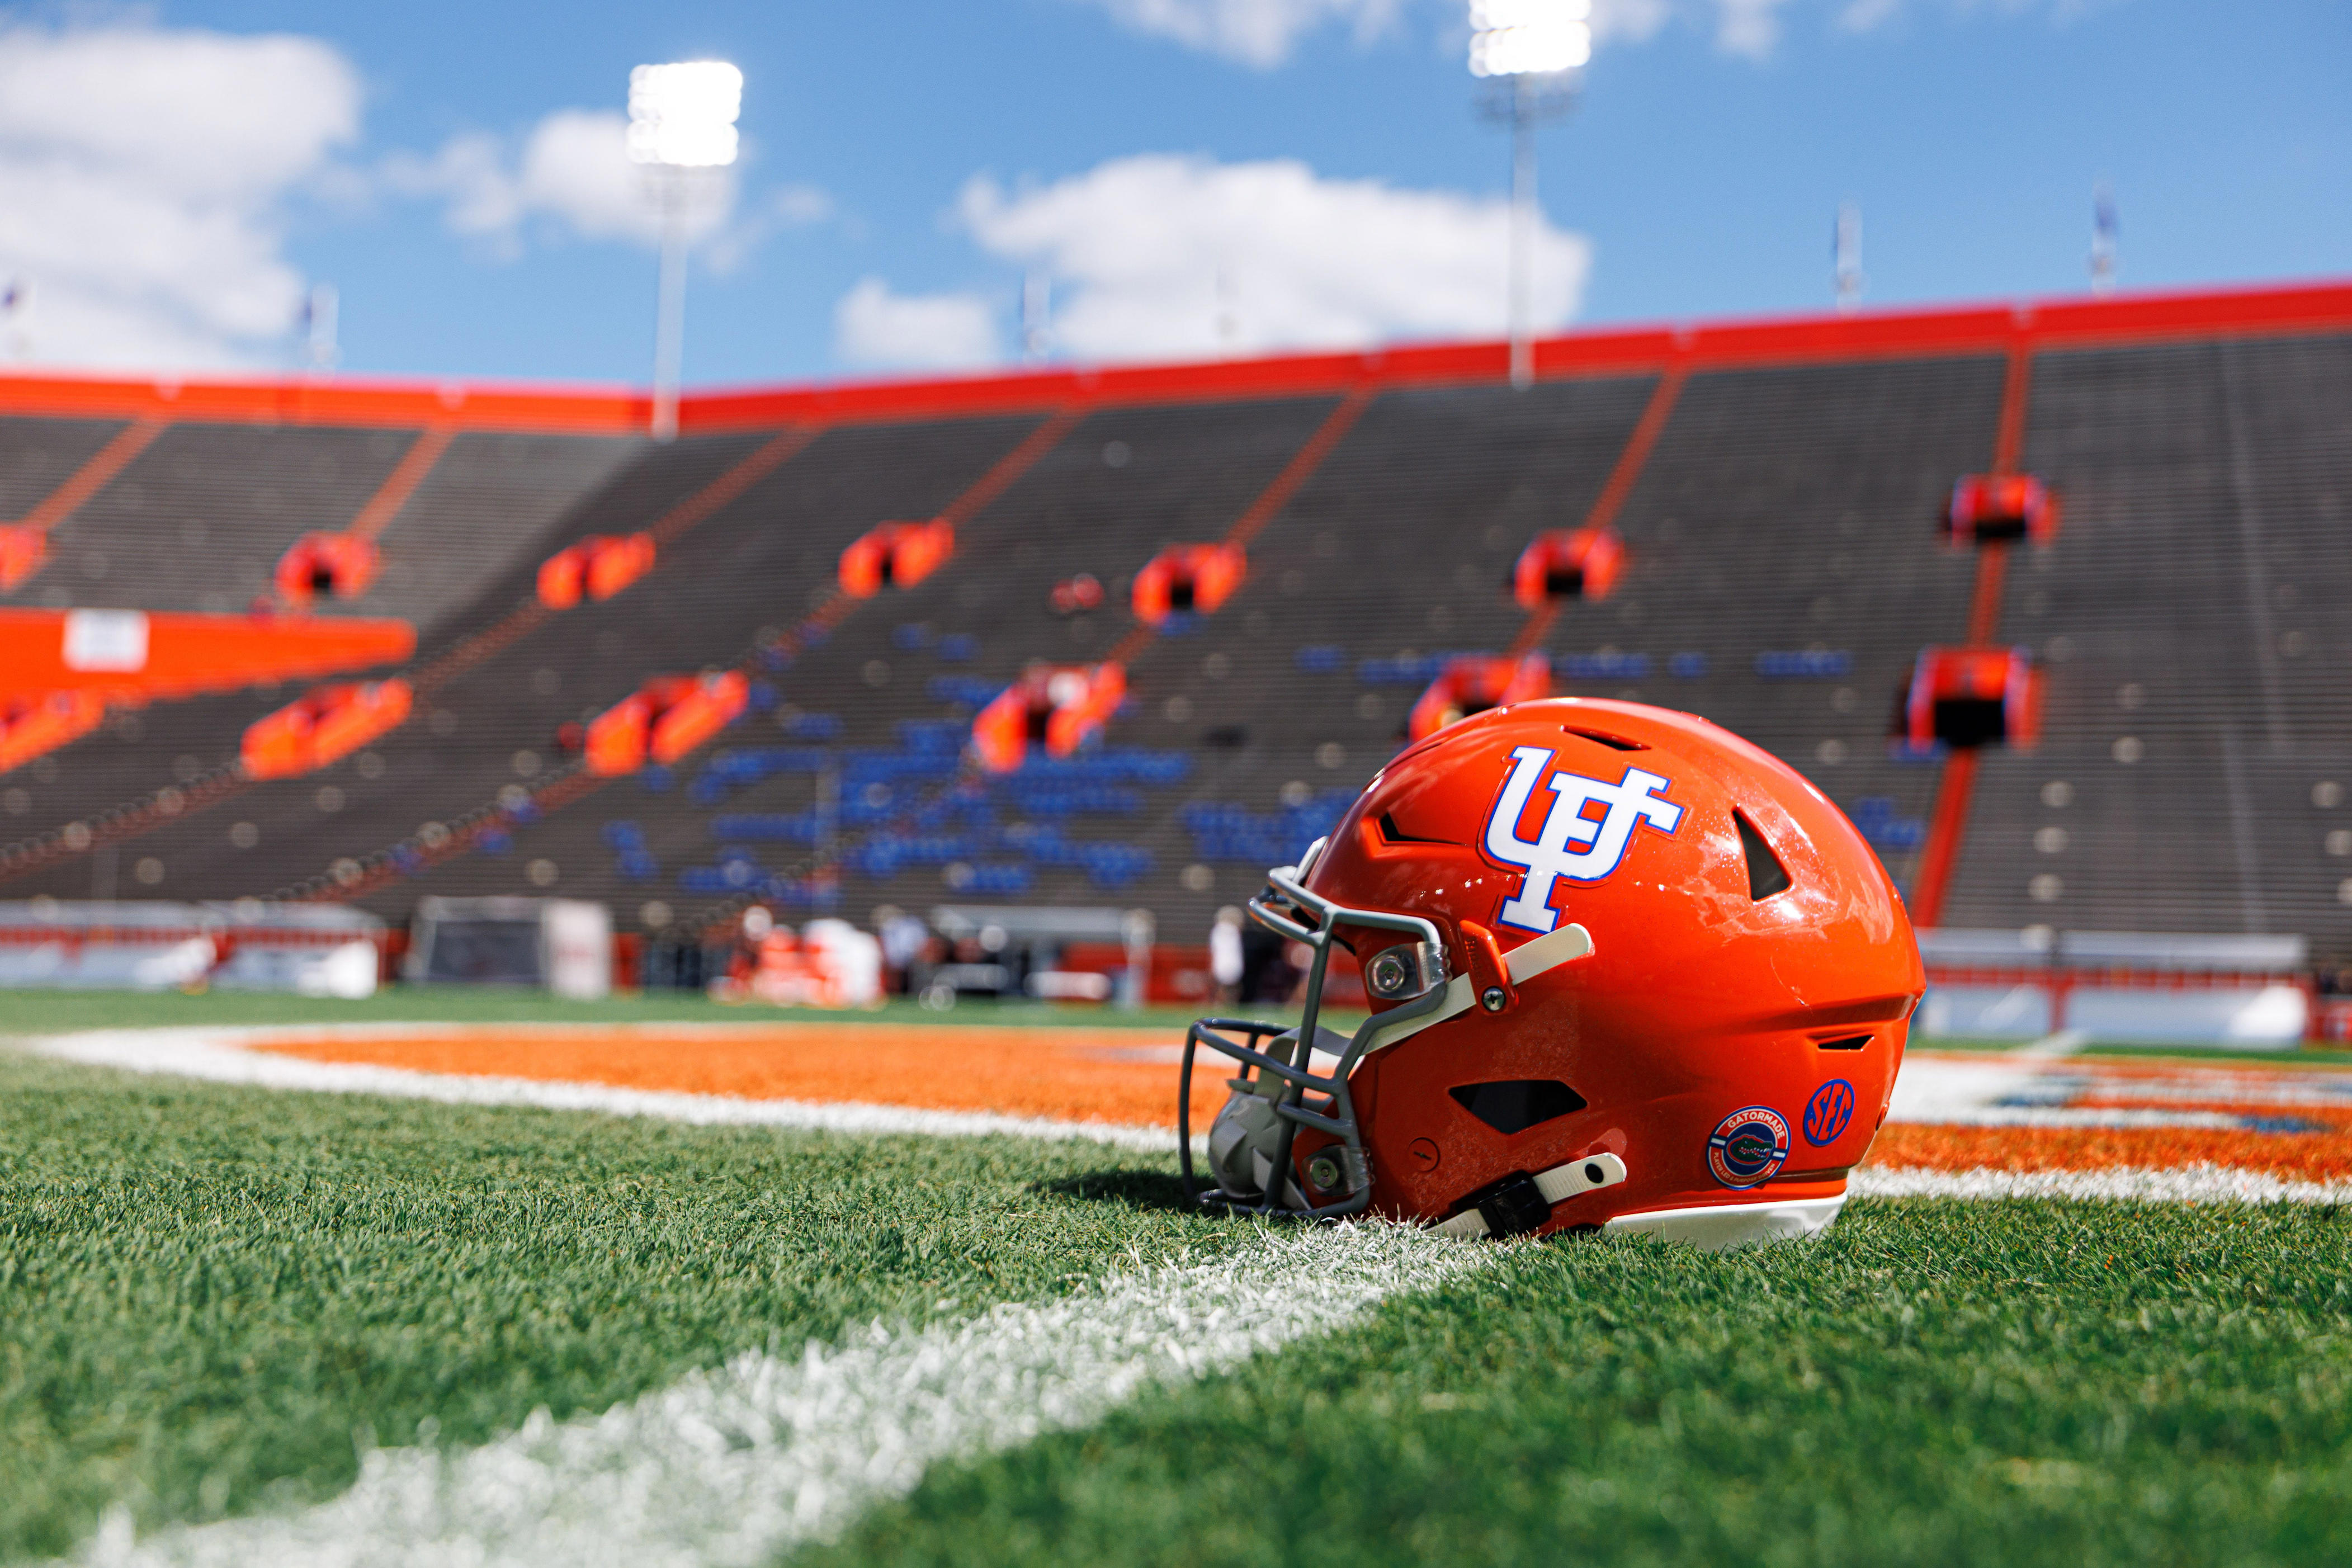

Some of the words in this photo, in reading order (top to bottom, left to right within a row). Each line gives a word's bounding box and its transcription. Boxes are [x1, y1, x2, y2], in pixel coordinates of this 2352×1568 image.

[1484, 745, 1684, 934] UF
[1727, 1112, 1786, 1139] GATORMADE
[1808, 1084, 1852, 1141] SEC
[1713, 1152, 1723, 1172] PLAYER
[1721, 1170, 1731, 1179] LED
